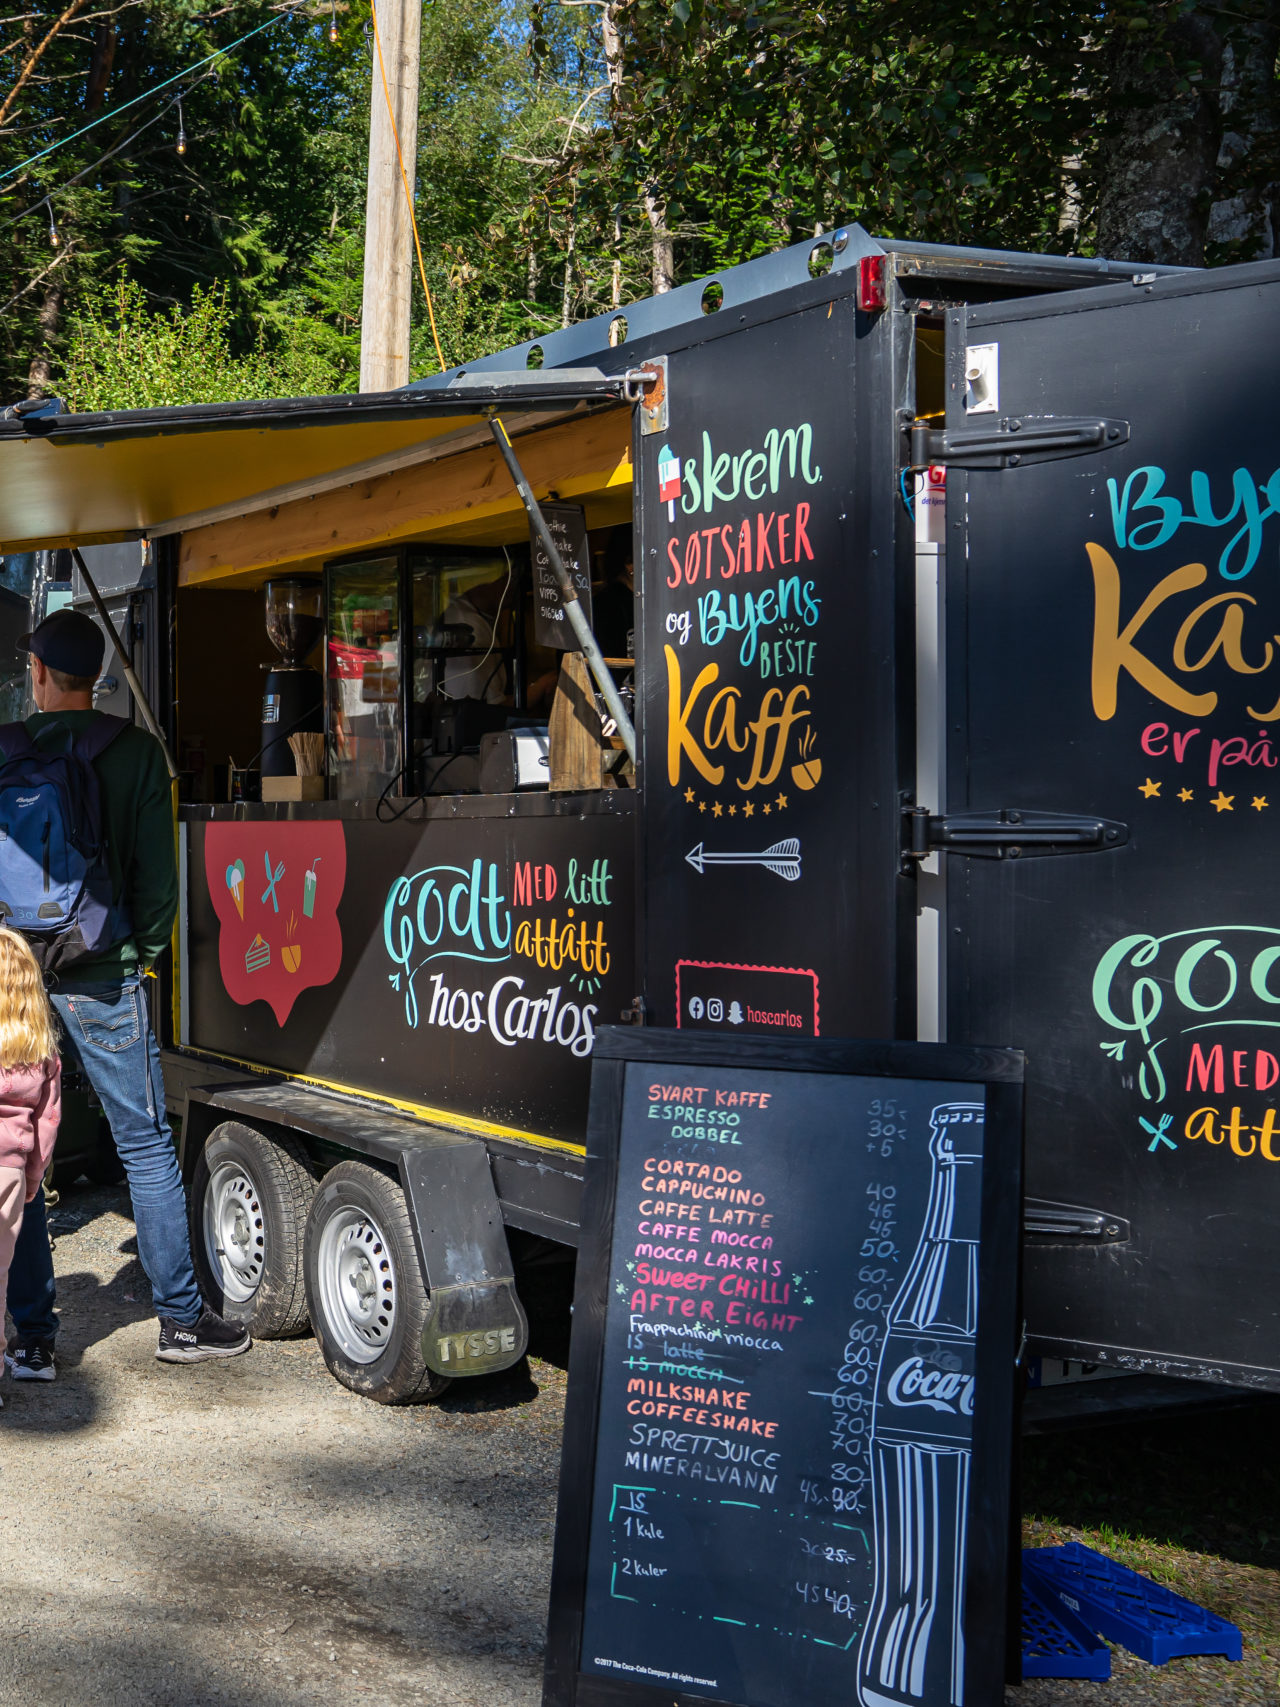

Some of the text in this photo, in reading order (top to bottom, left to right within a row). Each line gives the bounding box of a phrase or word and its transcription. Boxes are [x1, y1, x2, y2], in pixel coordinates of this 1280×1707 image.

[1107, 465, 1280, 581] By
[666, 502, 815, 589] SØTSAKER
[665, 575, 822, 666] og Byens
[1085, 541, 1280, 722] Ka
[760, 639, 817, 679] BESTE
[1140, 722, 1201, 764] er
[383, 858, 613, 964] Godt MED litt
[515, 908, 610, 975] attått
[747, 1005, 803, 1028] hoscarlos
[1185, 1042, 1279, 1094] MED
[648, 1084, 772, 1109] SVART KAFFE
[648, 1105, 741, 1126] ESPRESSO
[671, 1126, 743, 1145] DOBBEL
[644, 1158, 742, 1184] CORTADO
[641, 1176, 766, 1207] CAPPUCHINO
[866, 1183, 896, 1200] 40
[638, 1200, 774, 1228] CAFFE LATTE
[638, 1221, 774, 1250] CAFFE MOCCA
[634, 1243, 782, 1277] MOCCA LAKRIS
[173, 1331, 197, 1344] HOKA
[437, 1327, 515, 1362] TYSSE
[724, 1332, 784, 1352] mocca
[627, 1378, 751, 1411] MILKSHAKE
[626, 1400, 779, 1438] COFFEESHAKE
[629, 1423, 781, 1470] SPRETTJUICE
[625, 1451, 778, 1494] MINERALVANN
[623, 1517, 665, 1539] 1 kule
[621, 1558, 668, 1577] 2 kuler
[612, 1660, 622, 1669] The
[622, 1662, 647, 1674] Coca-Cola
[678, 1673, 694, 1683] rights
